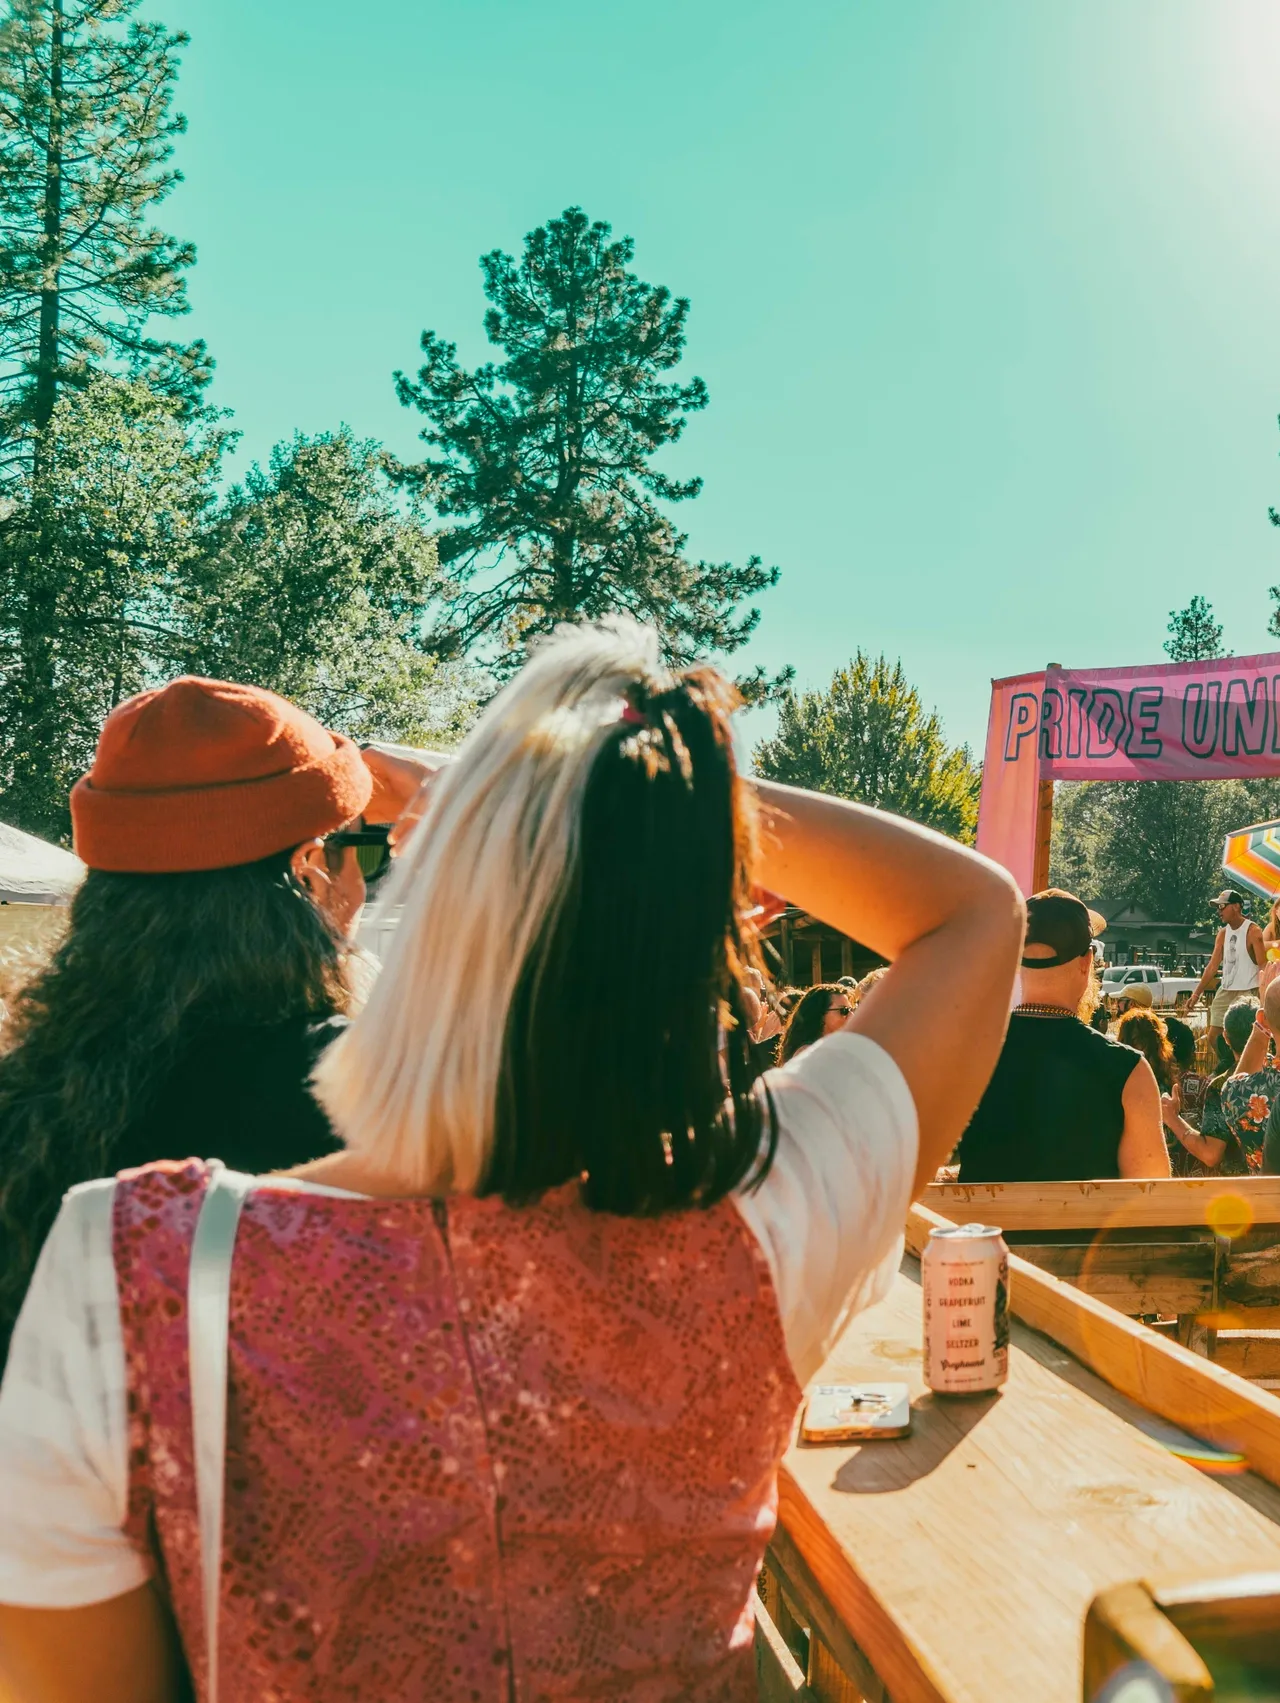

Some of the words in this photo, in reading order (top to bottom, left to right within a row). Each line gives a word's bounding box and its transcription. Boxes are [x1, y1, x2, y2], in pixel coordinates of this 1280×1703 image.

[1004, 686, 1163, 762] PRIDE
[948, 1276, 975, 1287] VODKA
[939, 1295, 986, 1307] GRAPEFRUIT
[952, 1318, 972, 1329] LIME
[945, 1339, 979, 1350] SELTZER
